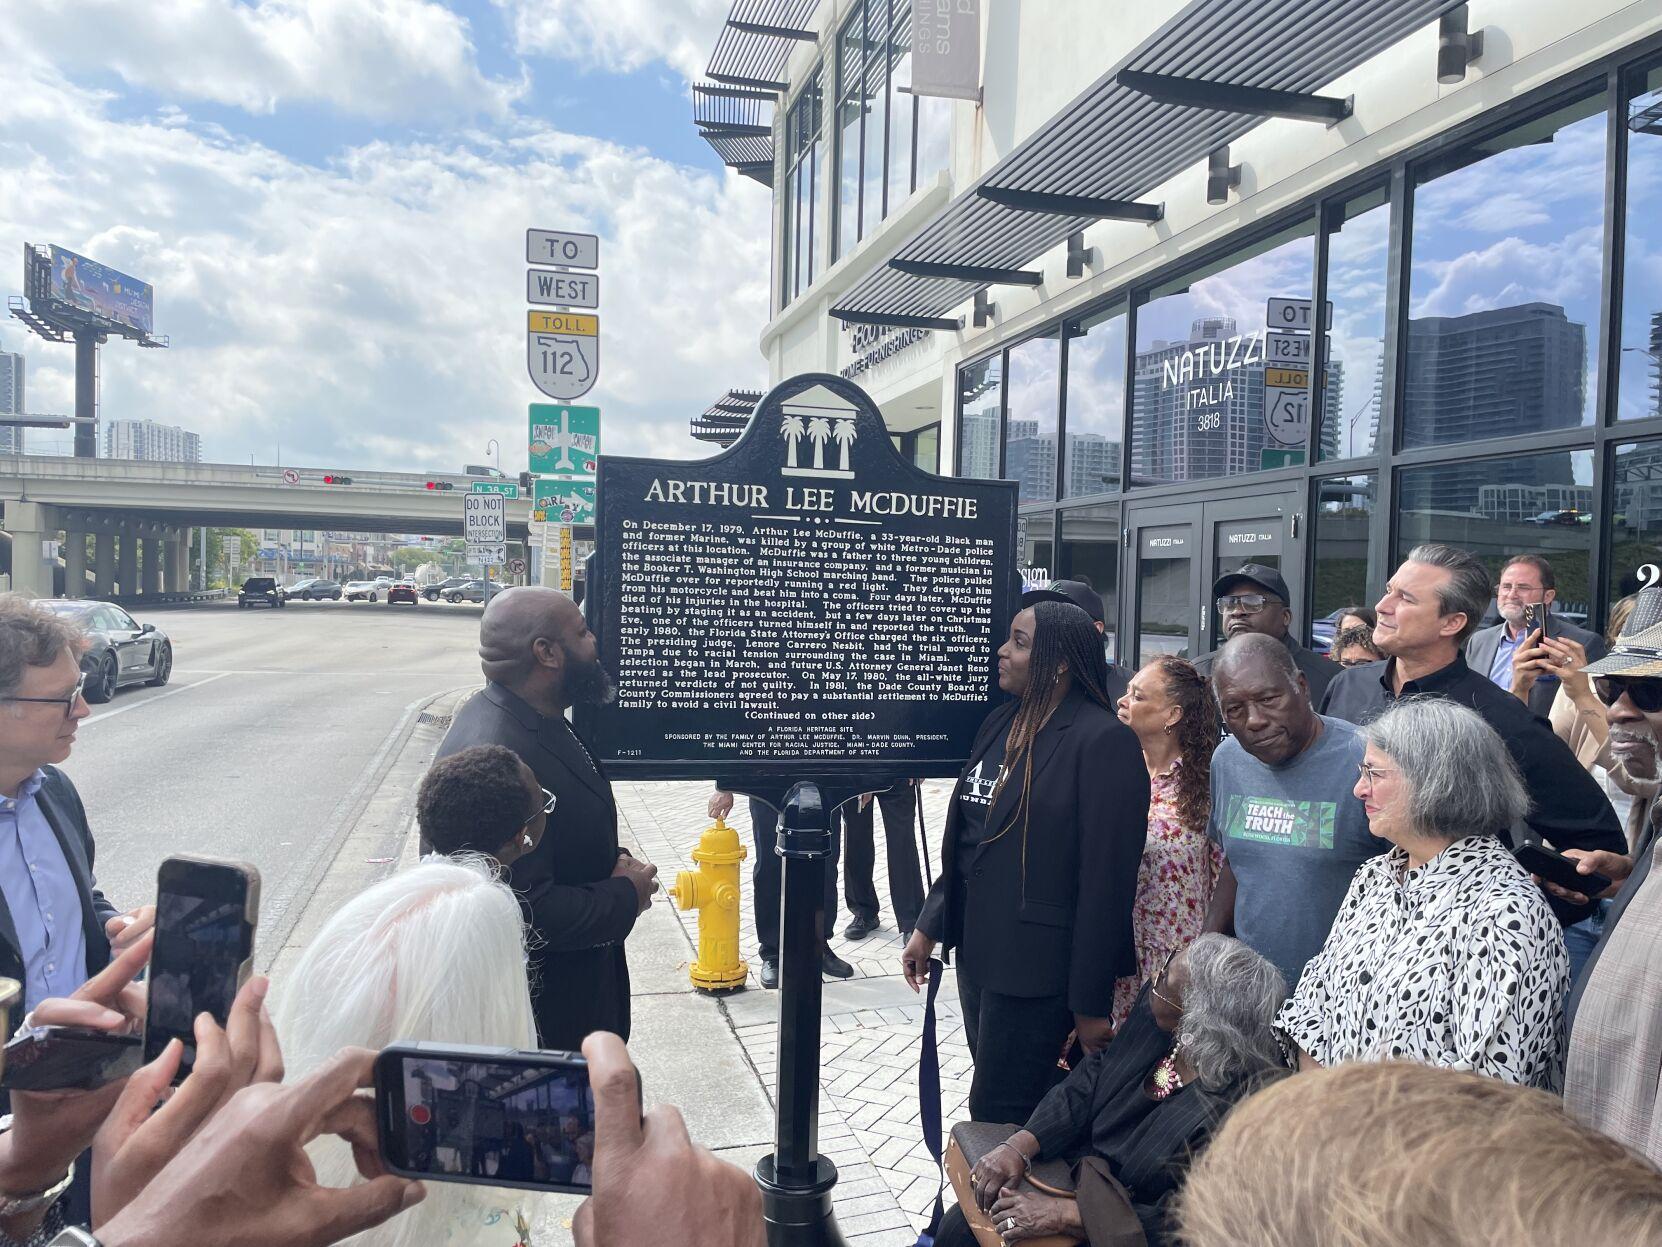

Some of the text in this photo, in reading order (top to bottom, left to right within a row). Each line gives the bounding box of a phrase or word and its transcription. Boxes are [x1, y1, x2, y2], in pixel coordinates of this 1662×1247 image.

[544, 238, 578, 260] TO
[538, 276, 588, 300] WEST
[542, 316, 584, 331] TOLL
[542, 350, 574, 376] 112
[1163, 328, 1266, 388] NATUZZI
[1187, 380, 1234, 410] ITALIA
[1197, 412, 1220, 432] 3818
[467, 499, 501, 510] DO NOT
[644, 478, 977, 518] ARTHUR LEE MCDUFFIE
[470, 516, 500, 526] BLOCK
[468, 530, 502, 538] INTERSECTION
[1149, 538, 1171, 547] NATUZZI
[1228, 534, 1256, 543] NATUZZI
[622, 541, 664, 551] officers
[682, 544, 702, 552] this
[706, 545, 749, 554] location.
[759, 547, 805, 557] McDuffie
[842, 551, 872, 560] father
[891, 553, 916, 561] three
[621, 562, 639, 570] the
[643, 562, 680, 572] Booker
[684, 564, 693, 573] T.
[697, 565, 755, 576] Washington
[759, 567, 782, 577] High
[786, 569, 818, 578] School
[823, 571, 867, 581] marching
[871, 572, 896, 581] band.
[932, 575, 960, 583] police
[964, 576, 992, 584] pulled
[1017, 560, 1048, 591] sign
[621, 572, 670, 582] McDuffie
[725, 578, 779, 588] reportedly
[784, 580, 822, 589] running
[862, 582, 888, 591] light.
[902, 583, 927, 593] They
[932, 585, 971, 594] dragged
[621, 594, 645, 602] died
[665, 595, 680, 603] his
[685, 596, 725, 606] injuries
[729, 597, 739, 606] in
[764, 599, 807, 608] hospital.
[846, 602, 884, 610] officers
[620, 646, 654, 656] Tampa
[662, 648, 680, 656] due
[742, 649, 778, 658] tension
[785, 651, 844, 660] surrounding
[918, 653, 949, 661] Miami.
[967, 654, 989, 663] Jury
[618, 689, 656, 698] County
[661, 689, 734, 698] Commissioners
[738, 691, 773, 699] agreed
[618, 699, 652, 708] family
[671, 700, 698, 708] avoid
[740, 700, 779, 708] lawsuit.
[744, 711, 800, 719] (Continued
[1248, 804, 1283, 818] TEACH
[1245, 816, 1294, 834] TRUTH
